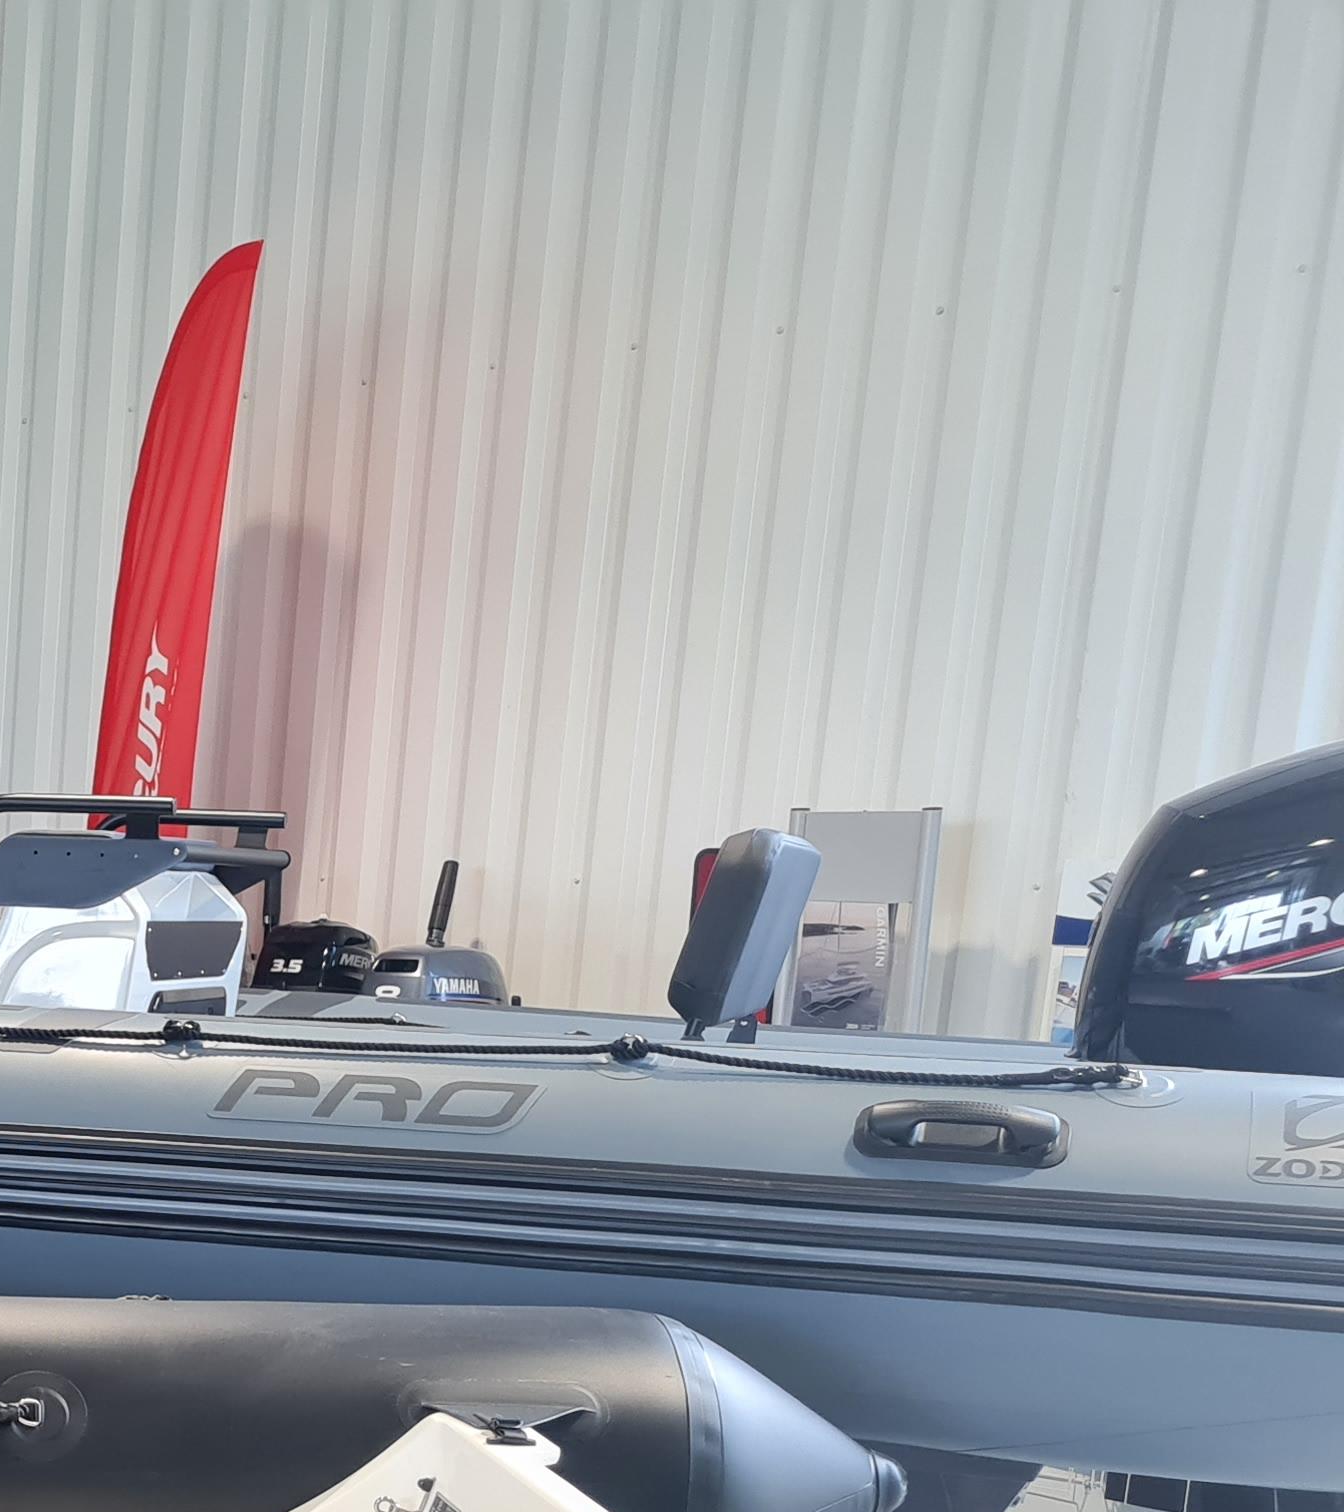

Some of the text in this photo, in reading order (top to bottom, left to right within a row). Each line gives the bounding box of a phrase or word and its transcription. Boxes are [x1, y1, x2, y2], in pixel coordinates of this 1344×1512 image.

[132, 617, 170, 796] URY
[270, 958, 303, 974] 3.5
[875, 906, 887, 969] GARMIN
[433, 978, 481, 995] YAMAHA
[212, 1068, 539, 1128] PRO
